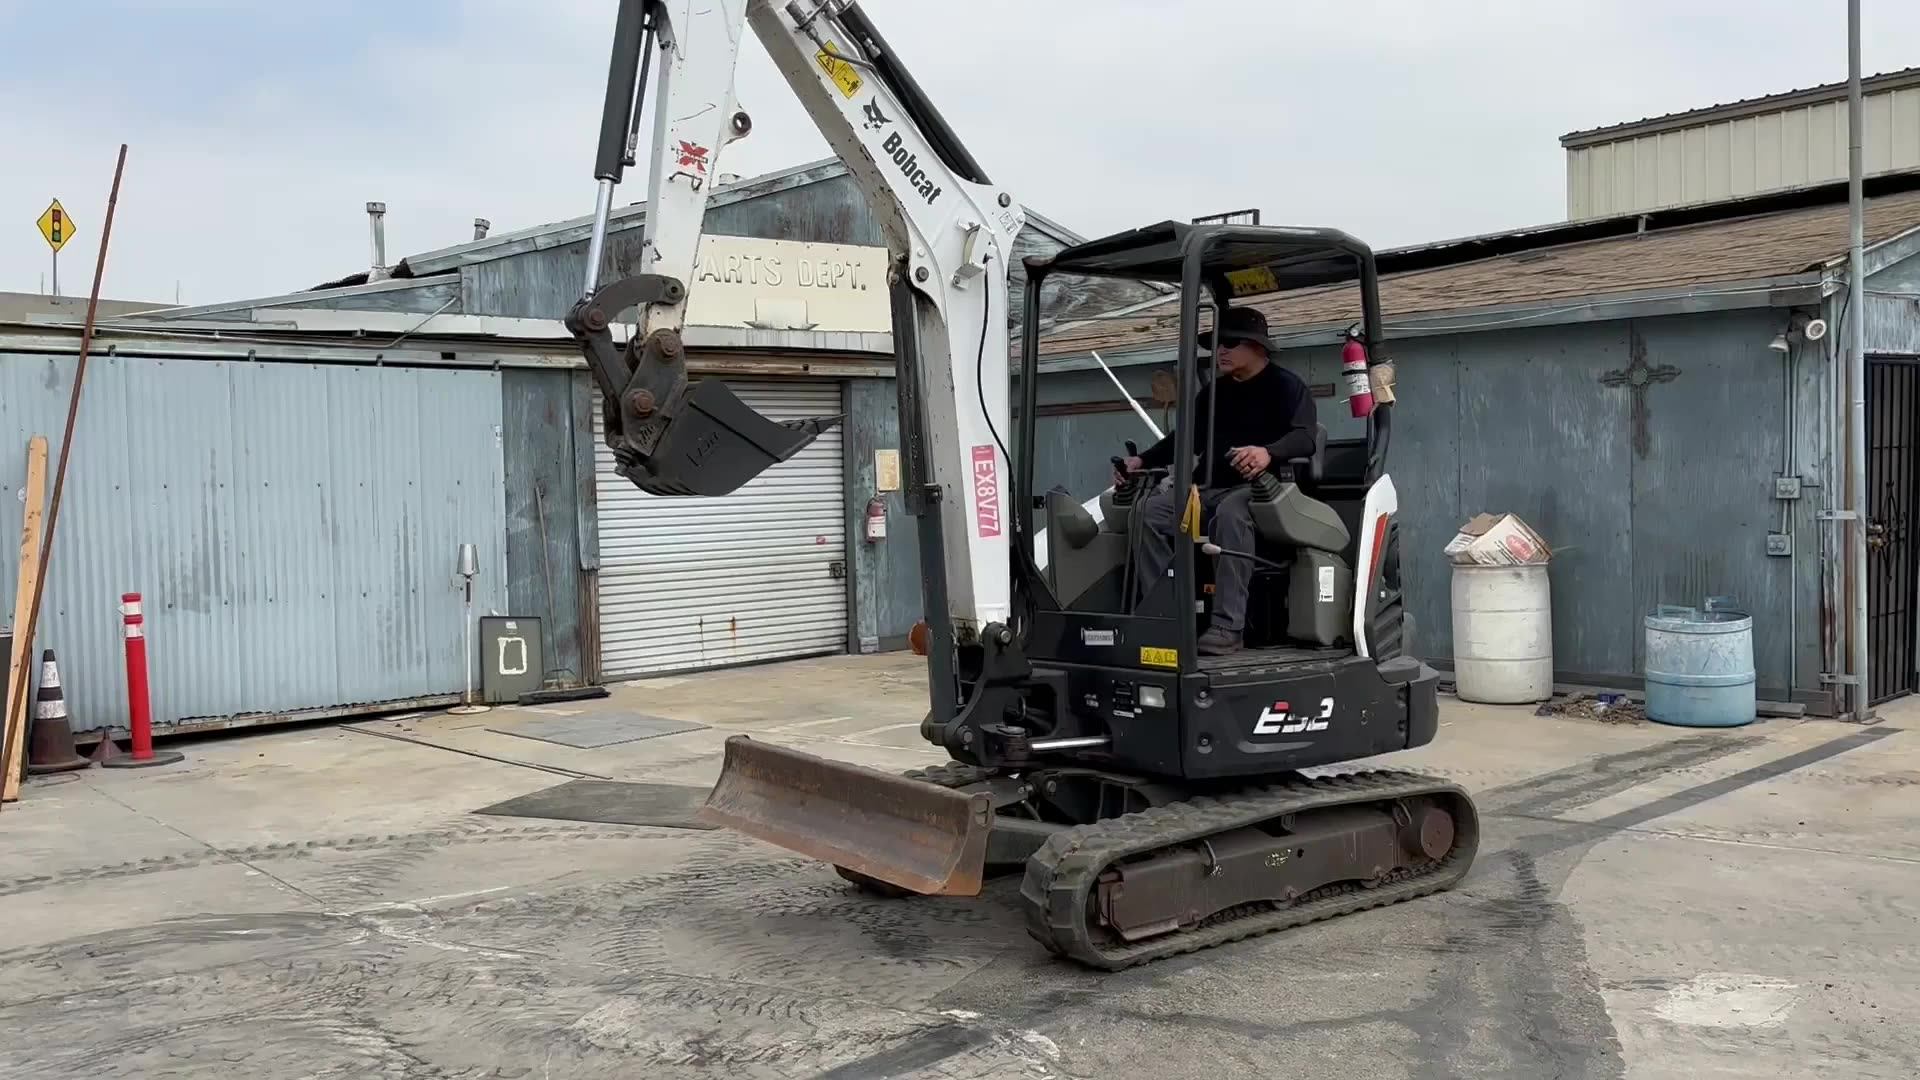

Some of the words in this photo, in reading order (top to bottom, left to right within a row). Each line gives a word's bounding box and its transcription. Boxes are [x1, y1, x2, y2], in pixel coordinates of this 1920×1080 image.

[882, 130, 942, 205] Bobcat
[694, 254, 783, 287] ARTS
[798, 257, 866, 291] DEPT.
[974, 459, 999, 532] EX8V77
